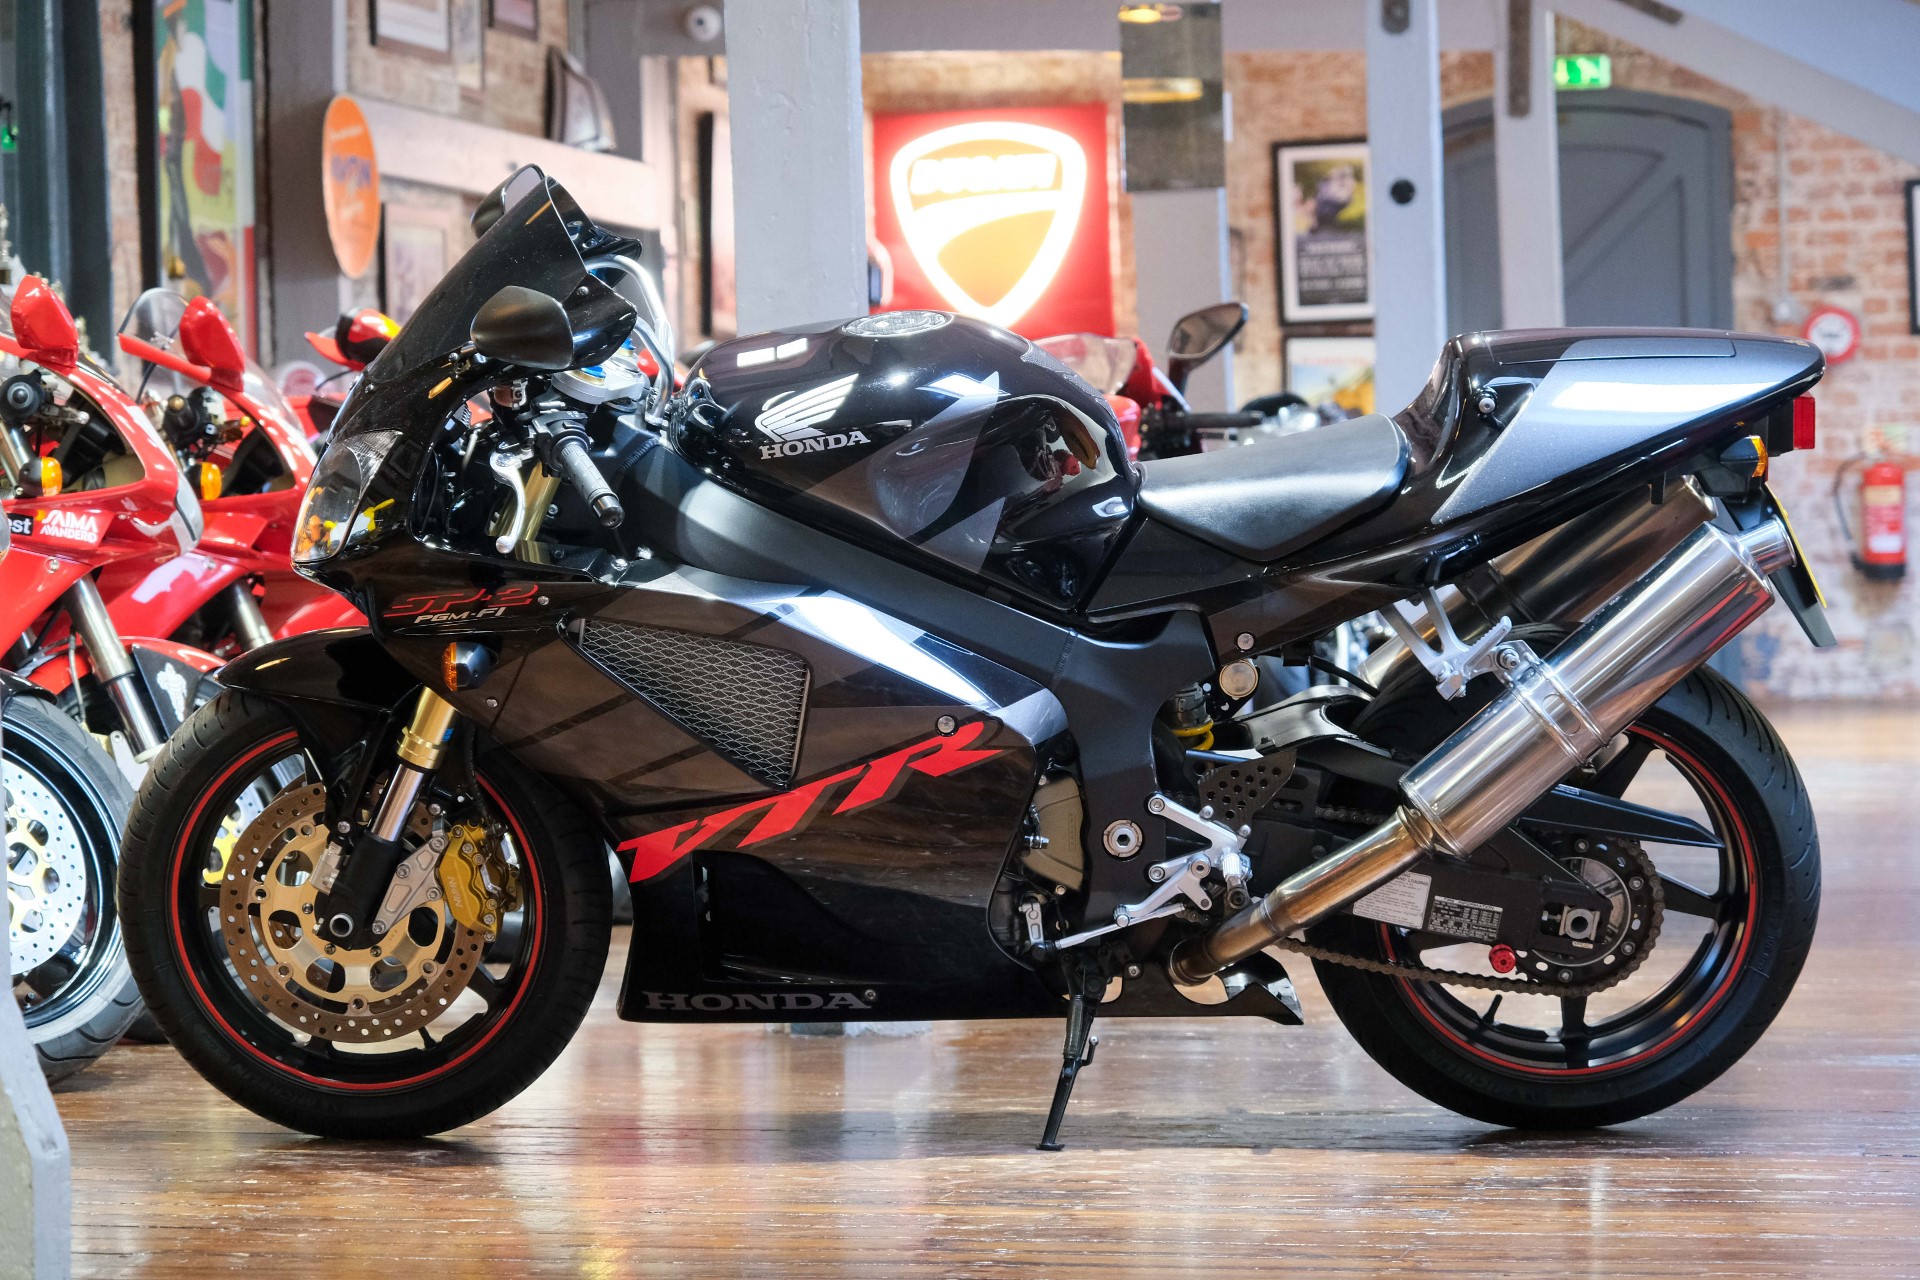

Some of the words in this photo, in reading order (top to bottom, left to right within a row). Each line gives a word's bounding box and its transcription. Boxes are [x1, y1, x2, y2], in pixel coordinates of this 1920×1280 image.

[759, 430, 871, 460] HONDA
[40, 524, 98, 544] AVANDERO
[41, 509, 98, 534] SAIMA
[615, 721, 1004, 883] VTR
[642, 990, 872, 1011] HONDA
